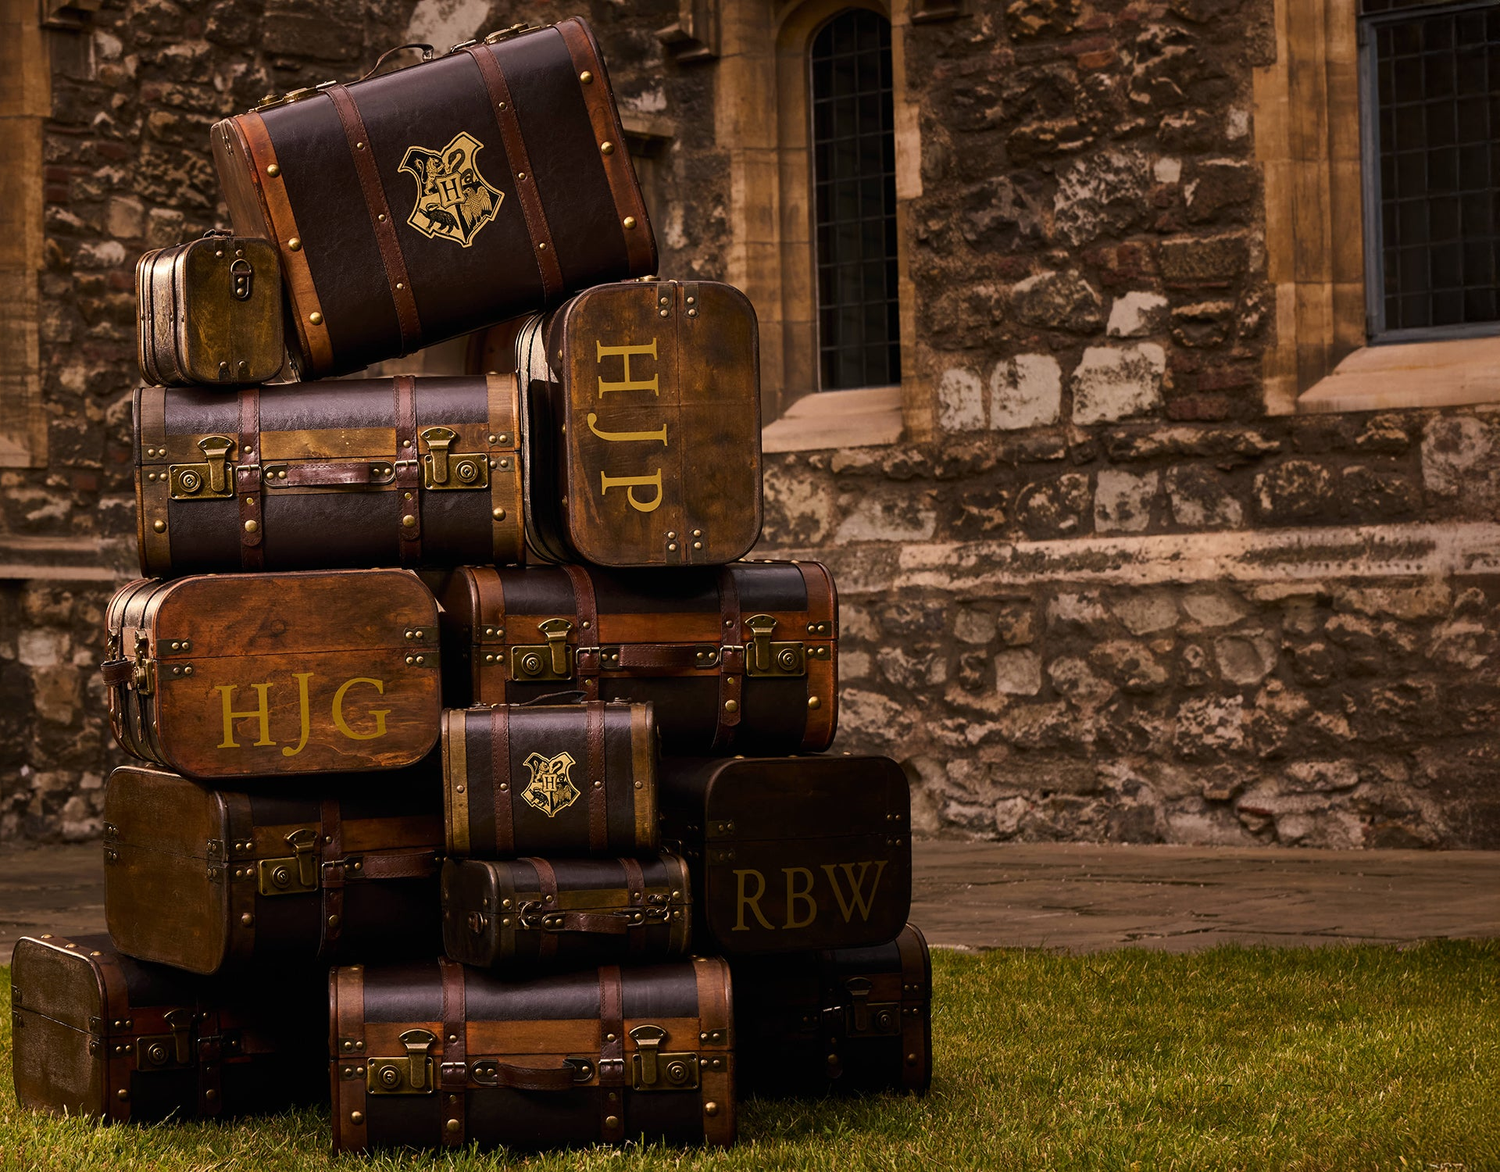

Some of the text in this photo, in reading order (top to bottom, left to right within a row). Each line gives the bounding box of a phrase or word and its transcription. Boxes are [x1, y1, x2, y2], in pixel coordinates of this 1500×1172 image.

[440, 178, 461, 202] H
[587, 337, 668, 513] HJP
[214, 671, 392, 757] HJG
[545, 777, 555, 789] H
[731, 860, 889, 931] RBW
